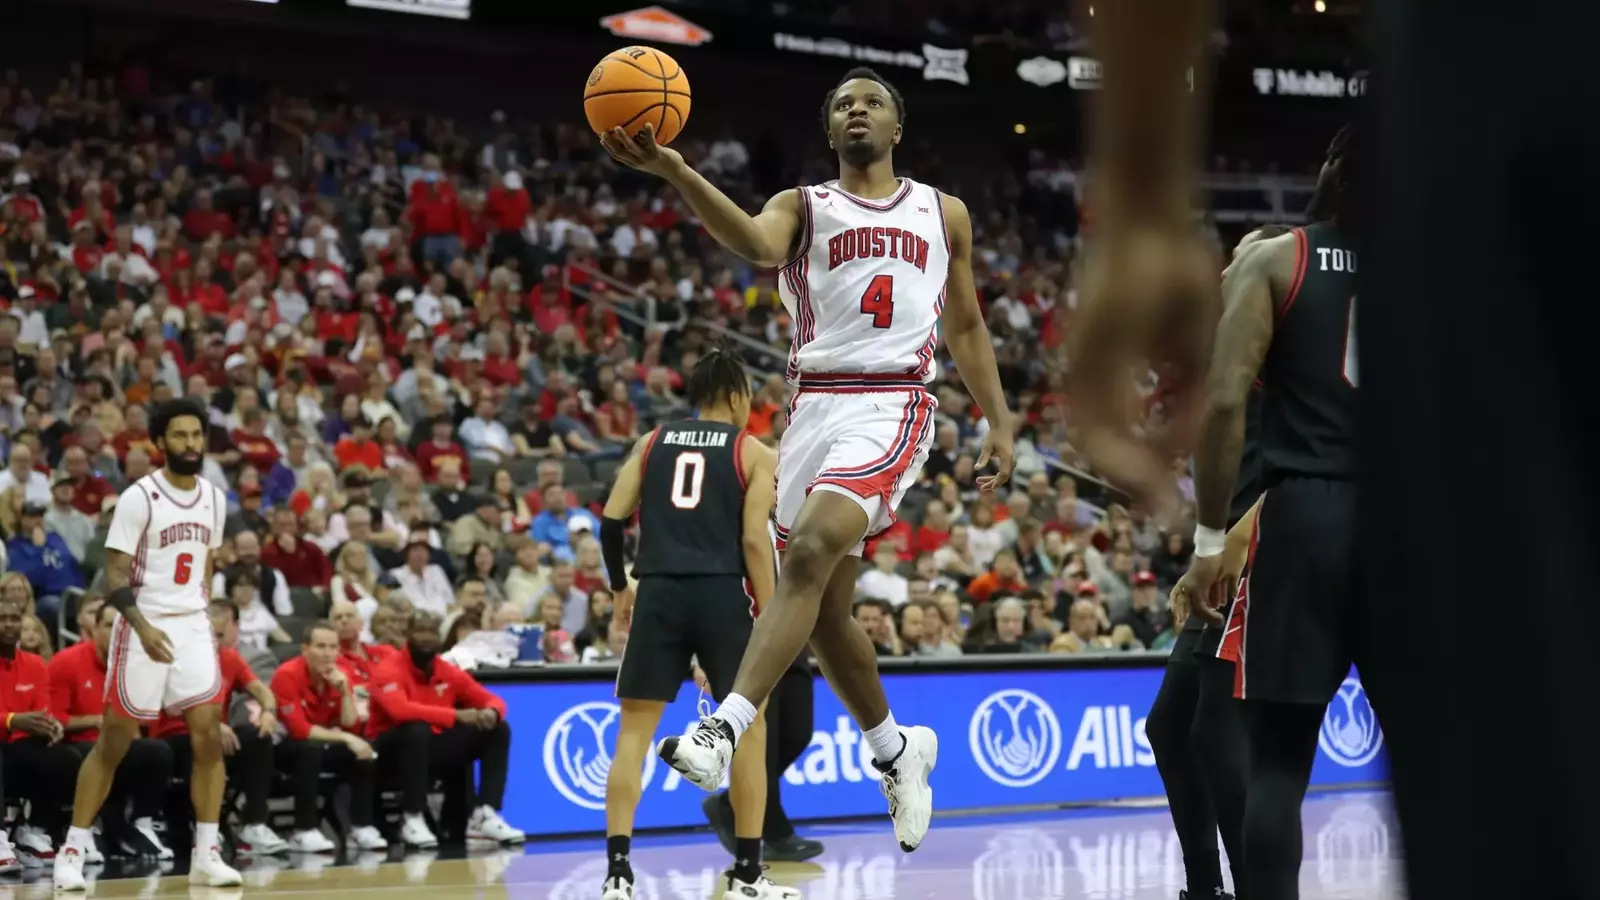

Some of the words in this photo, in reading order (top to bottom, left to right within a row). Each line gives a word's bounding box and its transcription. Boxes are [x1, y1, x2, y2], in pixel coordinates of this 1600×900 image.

[828, 227, 929, 274] HOUSTON
[860, 274, 894, 329] 4
[663, 431, 728, 447] McMILLIAN
[671, 451, 705, 509] 0
[174, 553, 193, 585] 6
